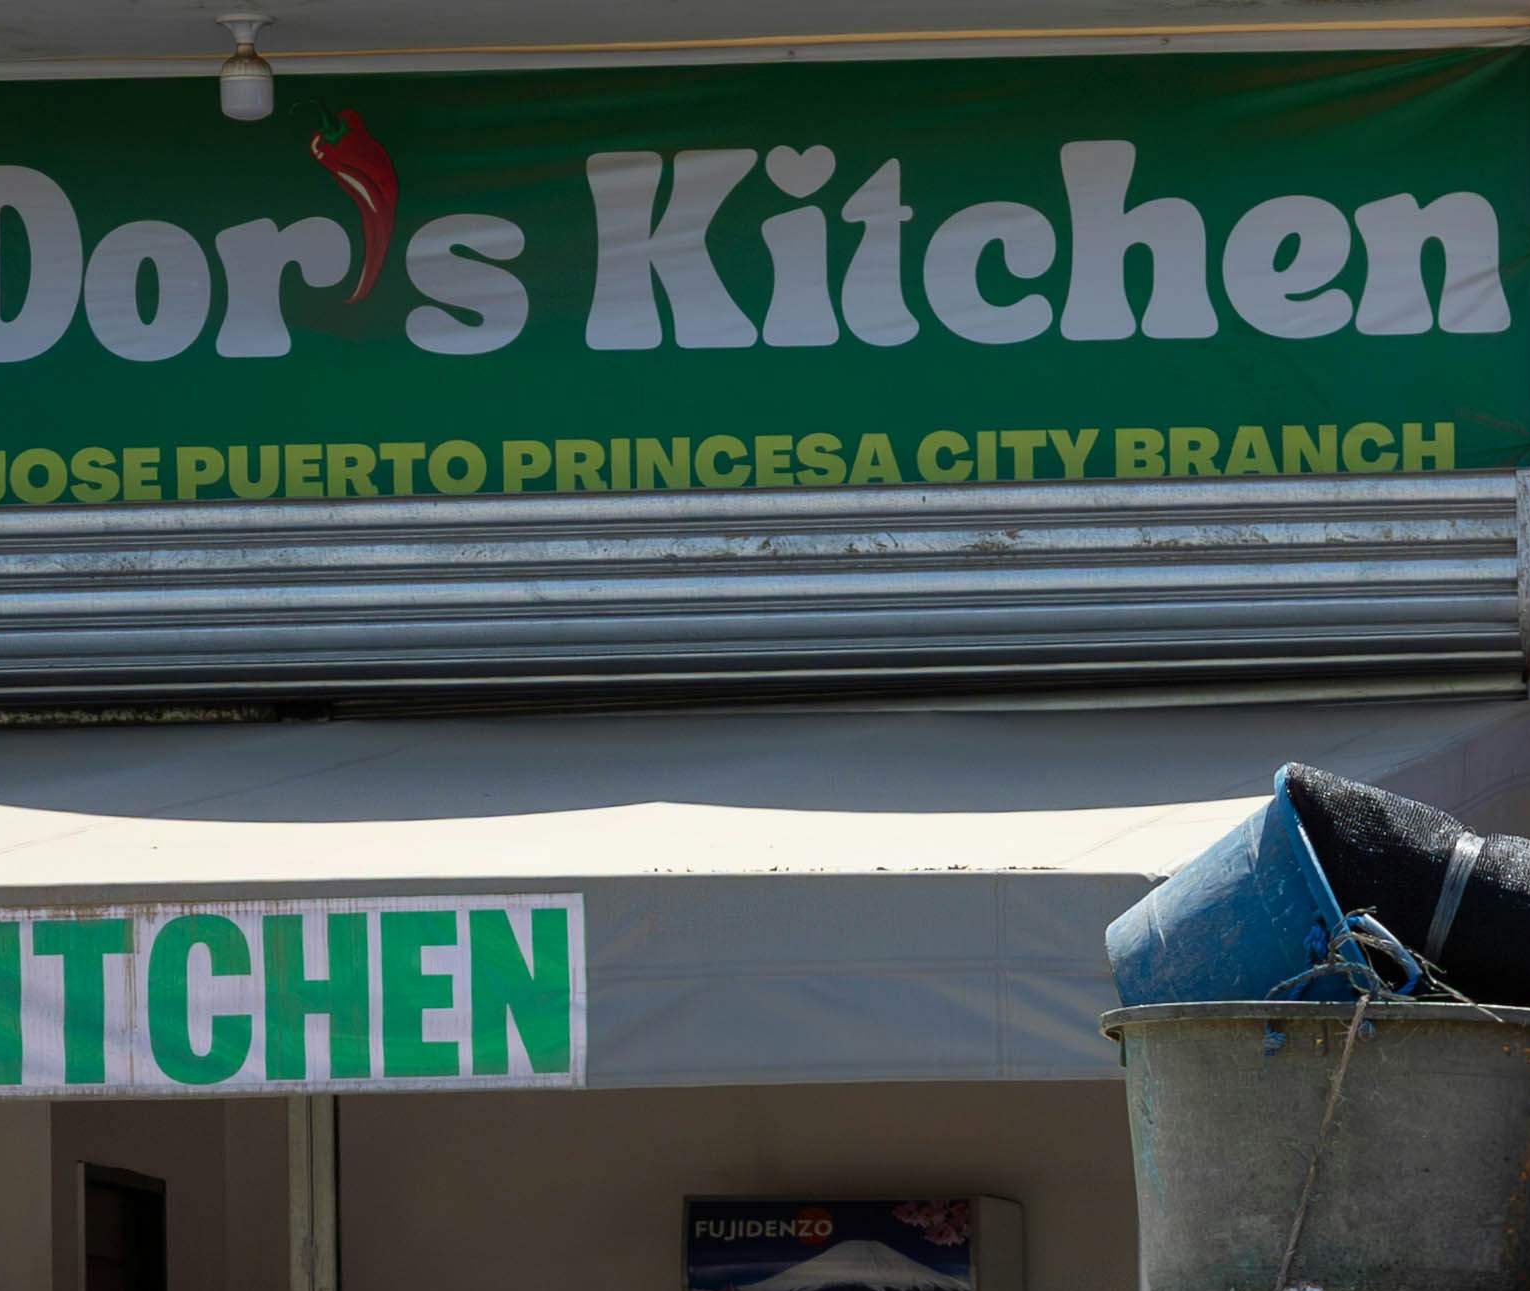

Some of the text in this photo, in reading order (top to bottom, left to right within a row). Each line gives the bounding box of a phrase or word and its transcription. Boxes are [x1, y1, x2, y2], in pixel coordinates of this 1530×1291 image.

[585, 139, 1511, 350] Kitchen
[176, 440, 486, 501] PUERTO
[502, 433, 903, 492] PRINCESA
[916, 428, 1099, 486] CITY
[1114, 422, 1457, 478] BRANCH
[693, 1218, 835, 1242] FUJIDENZO
